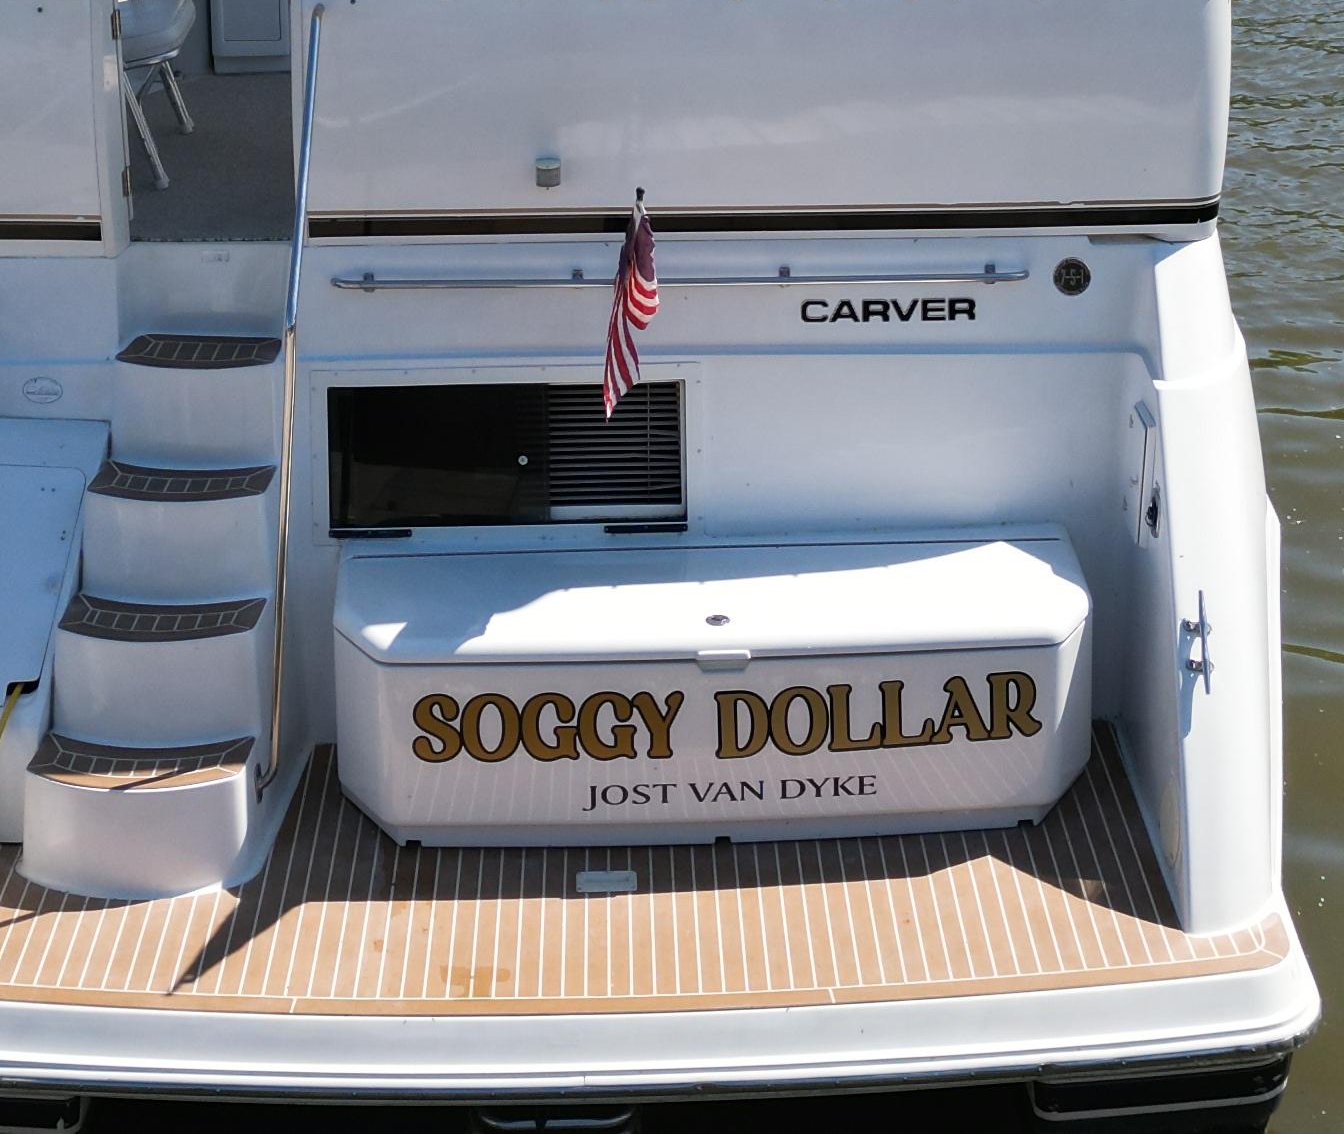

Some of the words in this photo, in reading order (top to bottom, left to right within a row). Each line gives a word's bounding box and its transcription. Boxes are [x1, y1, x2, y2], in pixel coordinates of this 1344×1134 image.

[800, 298, 977, 323] CARVER
[412, 690, 685, 763] SOGGY
[713, 670, 1043, 759] DOLLAR
[582, 783, 678, 812] JOST
[688, 780, 765, 804] VAN
[779, 774, 878, 801] DYKE
